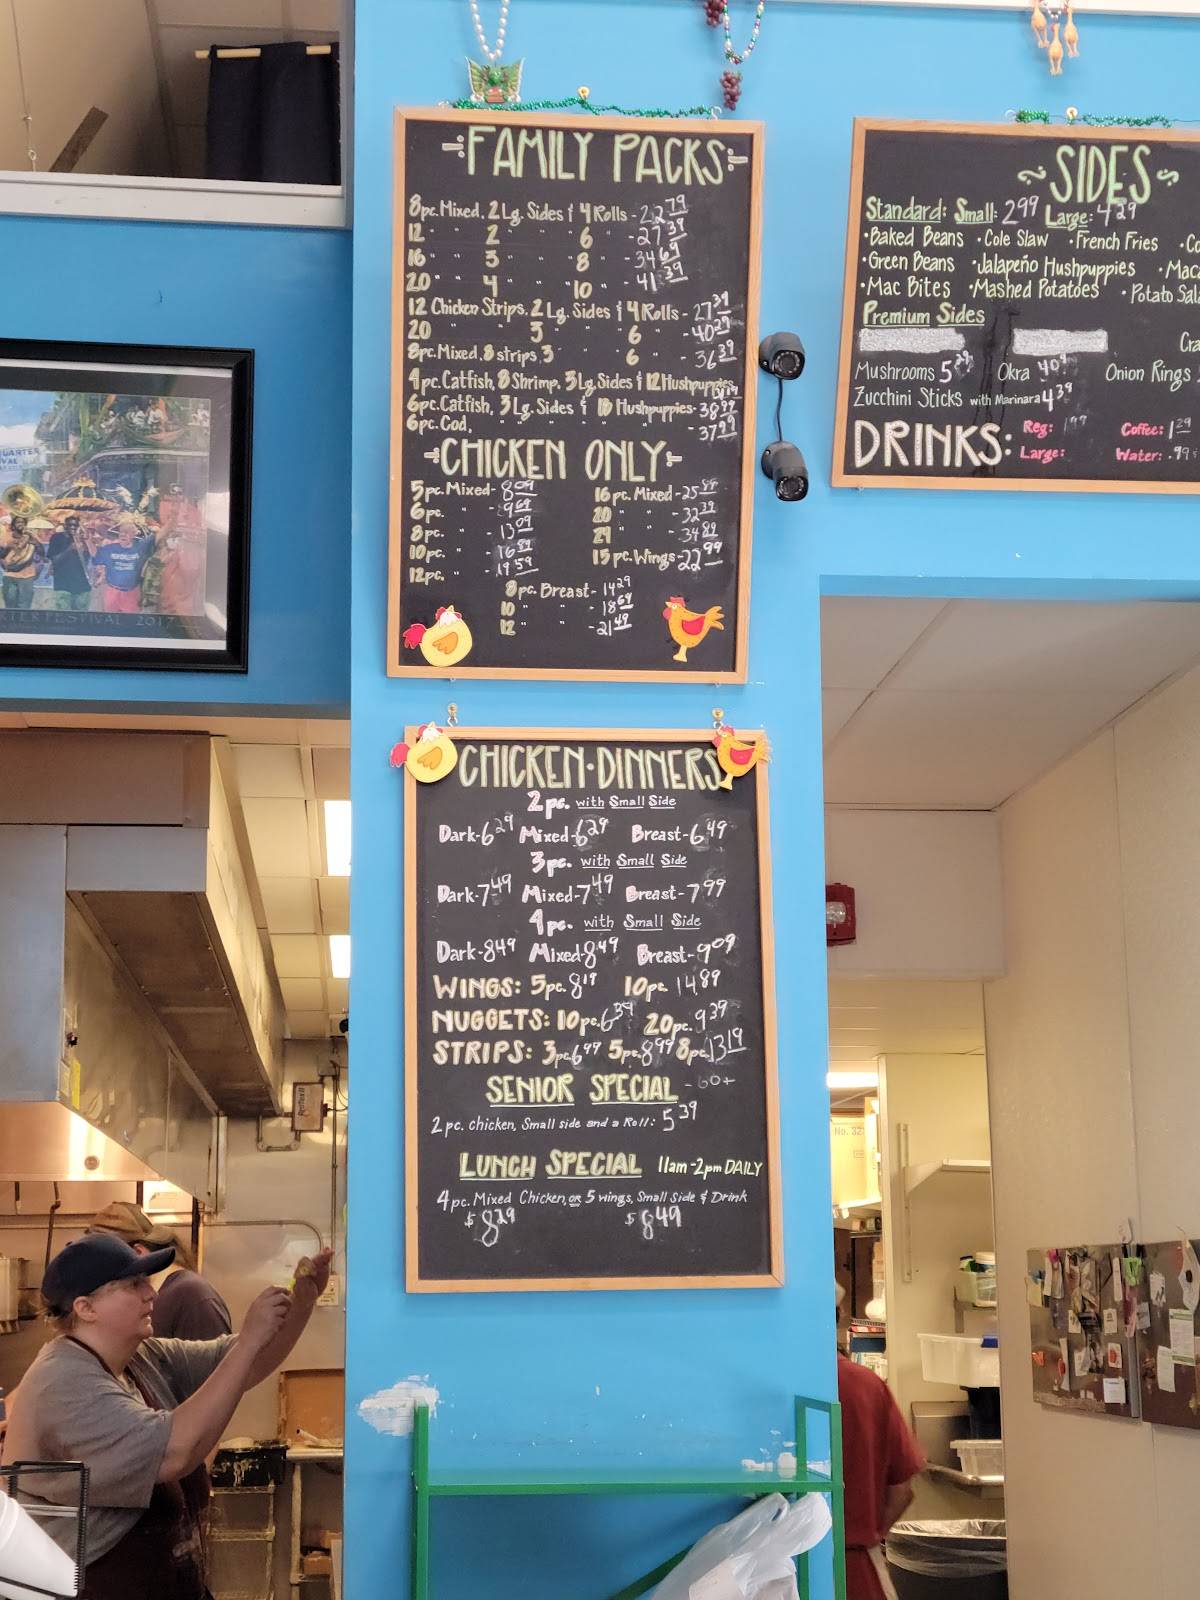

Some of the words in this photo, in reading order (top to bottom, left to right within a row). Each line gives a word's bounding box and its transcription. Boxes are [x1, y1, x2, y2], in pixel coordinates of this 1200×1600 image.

[468, 126, 593, 181] FAMILY
[613, 133, 725, 186] PACKS
[1050, 145, 1151, 204] SIDES
[527, 200, 564, 221] Sides
[579, 203, 591, 223] 4
[593, 205, 628, 222] Rolls
[408, 223, 425, 242] 12
[486, 224, 500, 245] 2
[580, 226, 593, 249] 6
[870, 226, 914, 247] Baked
[923, 225, 964, 247] Beans
[984, 228, 1010, 247] Cole
[1017, 228, 1049, 247] Slaw
[1076, 231, 1120, 250] French
[1124, 231, 1159, 251] Fries
[408, 248, 426, 267] 16
[485, 250, 499, 268] 3
[576, 252, 590, 272] 8
[868, 250, 908, 270] Green
[913, 250, 955, 272] Beans
[1044, 256, 1135, 286] Hushpuppies
[1165, 259, 1200, 280] Mac
[406, 272, 431, 292] 20
[483, 275, 497, 297] 4
[573, 280, 592, 299] 10
[866, 276, 901, 296] Mac
[907, 276, 950, 298] Bites
[973, 279, 1032, 298] Mashed
[1038, 278, 1100, 299] Potatoes
[1131, 283, 1173, 304] Potato
[408, 297, 427, 316] 12
[431, 297, 479, 315] Chicken
[530, 298, 544, 317] 2
[572, 302, 610, 319] Sides
[627, 300, 640, 322] 4
[641, 303, 679, 321] Rolls
[863, 300, 931, 327] Premium
[936, 302, 985, 326] Sides
[407, 319, 432, 340] 20
[530, 321, 544, 343] 3
[628, 325, 642, 345] 6
[626, 348, 640, 366] 6
[597, 372, 633, 389] Sides
[855, 360, 935, 380] Mushrooms
[998, 362, 1030, 381] Okra
[1106, 362, 1144, 382] Onion
[1151, 359, 1191, 392] Rings
[536, 398, 574, 415] Sides
[854, 385, 912, 407] Zucchini
[917, 387, 963, 408] Sticks
[970, 394, 991, 406] with
[994, 393, 1040, 405] Marinara
[441, 437, 566, 480] CHICKEN
[585, 439, 667, 482] ONLY
[500, 619, 516, 636] 12
[575, 796, 605, 810] with
[609, 794, 645, 809] Small
[648, 794, 677, 809] Side
[581, 853, 611, 869] with
[616, 852, 655, 869] Small
[660, 852, 688, 868] Side
[584, 915, 615, 932] with
[623, 913, 664, 931] Small
[670, 912, 702, 930] Side
[485, 1073, 575, 1107] SENIOR
[589, 1073, 679, 1105] SPECIAL
[521, 1117, 556, 1131] Small
[559, 1117, 581, 1129] side
[586, 1117, 609, 1128] and
[612, 1120, 619, 1128] a
[459, 1152, 537, 1180] LUNCH
[544, 1149, 643, 1179] SPECIAL
[724, 1159, 763, 1177] DAILY
[473, 1192, 512, 1206] Mixed
[585, 1189, 596, 1203] 5
[637, 1190, 667, 1203] Small
[670, 1191, 695, 1204] Side
[711, 1189, 747, 1204] Drink
